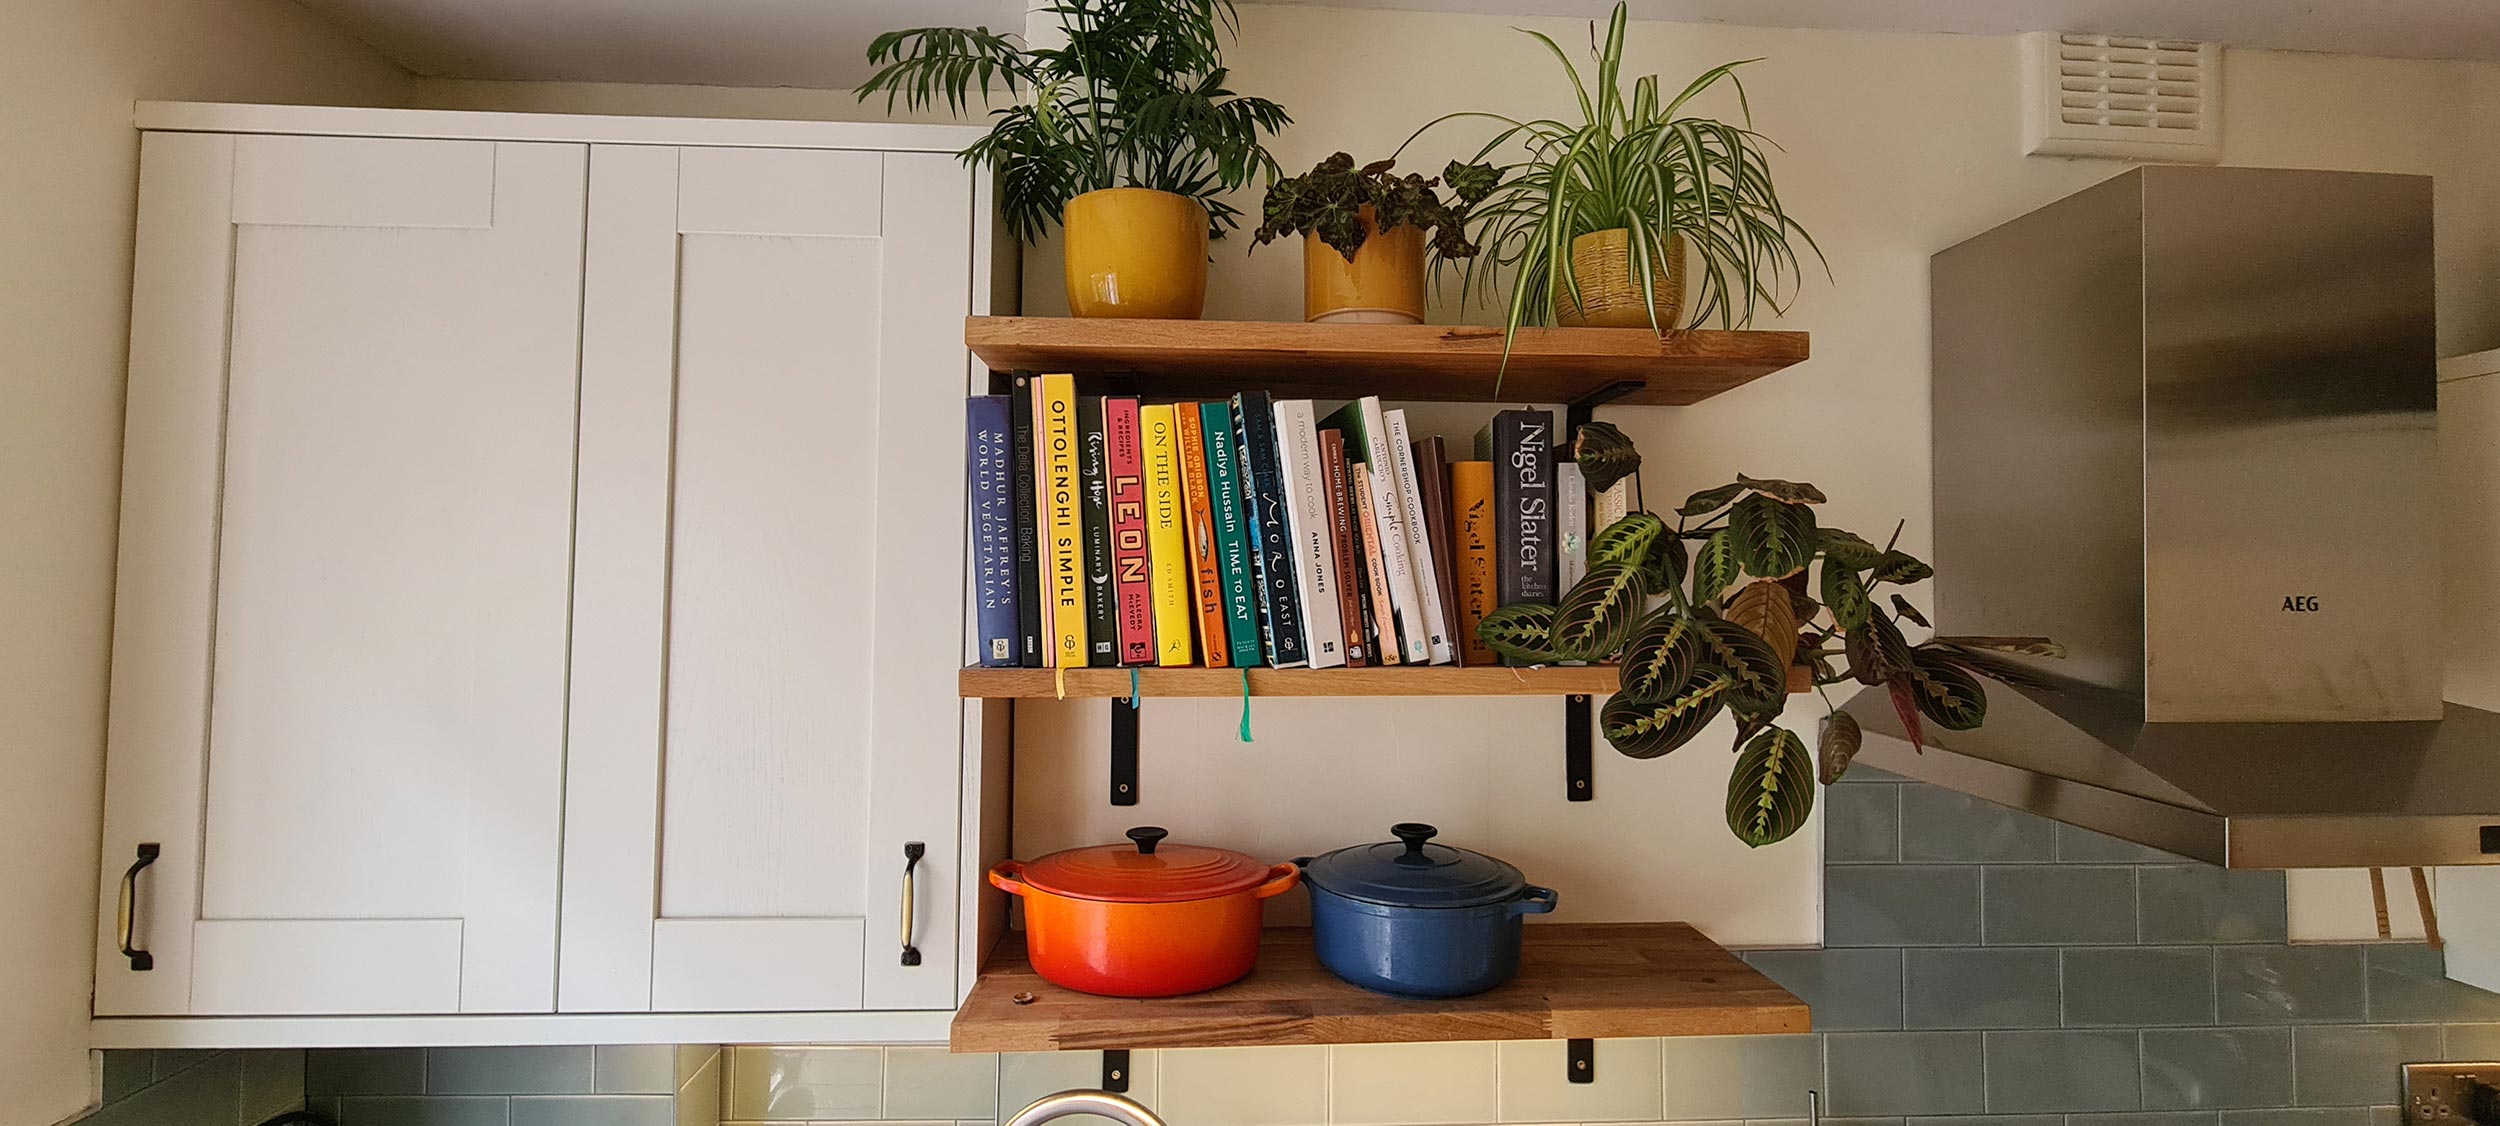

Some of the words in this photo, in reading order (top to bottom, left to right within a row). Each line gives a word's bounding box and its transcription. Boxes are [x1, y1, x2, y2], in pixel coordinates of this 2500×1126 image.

[1016, 425, 1029, 443] The
[1123, 410, 1132, 464] INGREDIENTS
[1154, 422, 1167, 447] ON
[1188, 416, 1199, 451] SOPHIE
[1297, 420, 1309, 459] modern
[1393, 421, 1401, 436] THE
[978, 430, 990, 490] WORLD
[1018, 447, 1030, 471] Delia
[1052, 400, 1071, 526] OTTOLENGHI
[1083, 431, 1102, 476] Rising
[1184, 428, 1195, 469] WILLIAM
[1379, 443, 1390, 475] ANTONIO
[1396, 438, 1412, 494] CORNERSHOP
[1511, 421, 1546, 489] Nigel
[994, 433, 1006, 506] MADHUR
[1155, 451, 1169, 486] THE
[1193, 455, 1205, 498] GRIGSON
[1214, 431, 1228, 477] Nadiya
[1221, 481, 1236, 533] Hussain
[1302, 460, 1313, 480] way
[1018, 473, 1032, 523] Collection
[1088, 480, 1104, 509] Hope
[1188, 473, 1199, 503] BLACK
[1306, 482, 1313, 493] to
[1358, 480, 1367, 510] STUDENT
[1158, 490, 1172, 529] SIDE
[1307, 495, 1318, 520] cook
[1383, 491, 1404, 531] Simple
[1406, 496, 1420, 545] COOKBOOK
[1020, 527, 1033, 562] Baking
[1114, 475, 1146, 584] LEON
[1311, 532, 1321, 559] ANNA
[1363, 511, 1376, 557] ORIENTAL
[1520, 497, 1546, 572] Slater
[981, 501, 995, 609] VEGETARIAN
[995, 516, 1014, 604] JAFFREY'S
[1093, 526, 1102, 573] LUMINARY
[1340, 533, 1351, 568] PROBLEM
[1371, 558, 1379, 577] COOK
[1392, 533, 1406, 576] Cooking
[1058, 537, 1074, 606] SIMPLE
[1166, 563, 1172, 574] ED
[1228, 540, 1242, 575] TIME
[1235, 595, 1248, 621] EAT
[1315, 562, 1325, 593] JONES
[1344, 571, 1353, 597] SOLVER
[1374, 577, 1383, 596] BOOK
[1521, 575, 1533, 583] the
[1096, 586, 1105, 620] BAKERY
[1167, 577, 1175, 606] SMITH
[1200, 568, 1217, 613] fish
[2282, 596, 2319, 611] AEG
[1135, 594, 1143, 631] ALLEGRA
[1278, 596, 1291, 626] EAST
